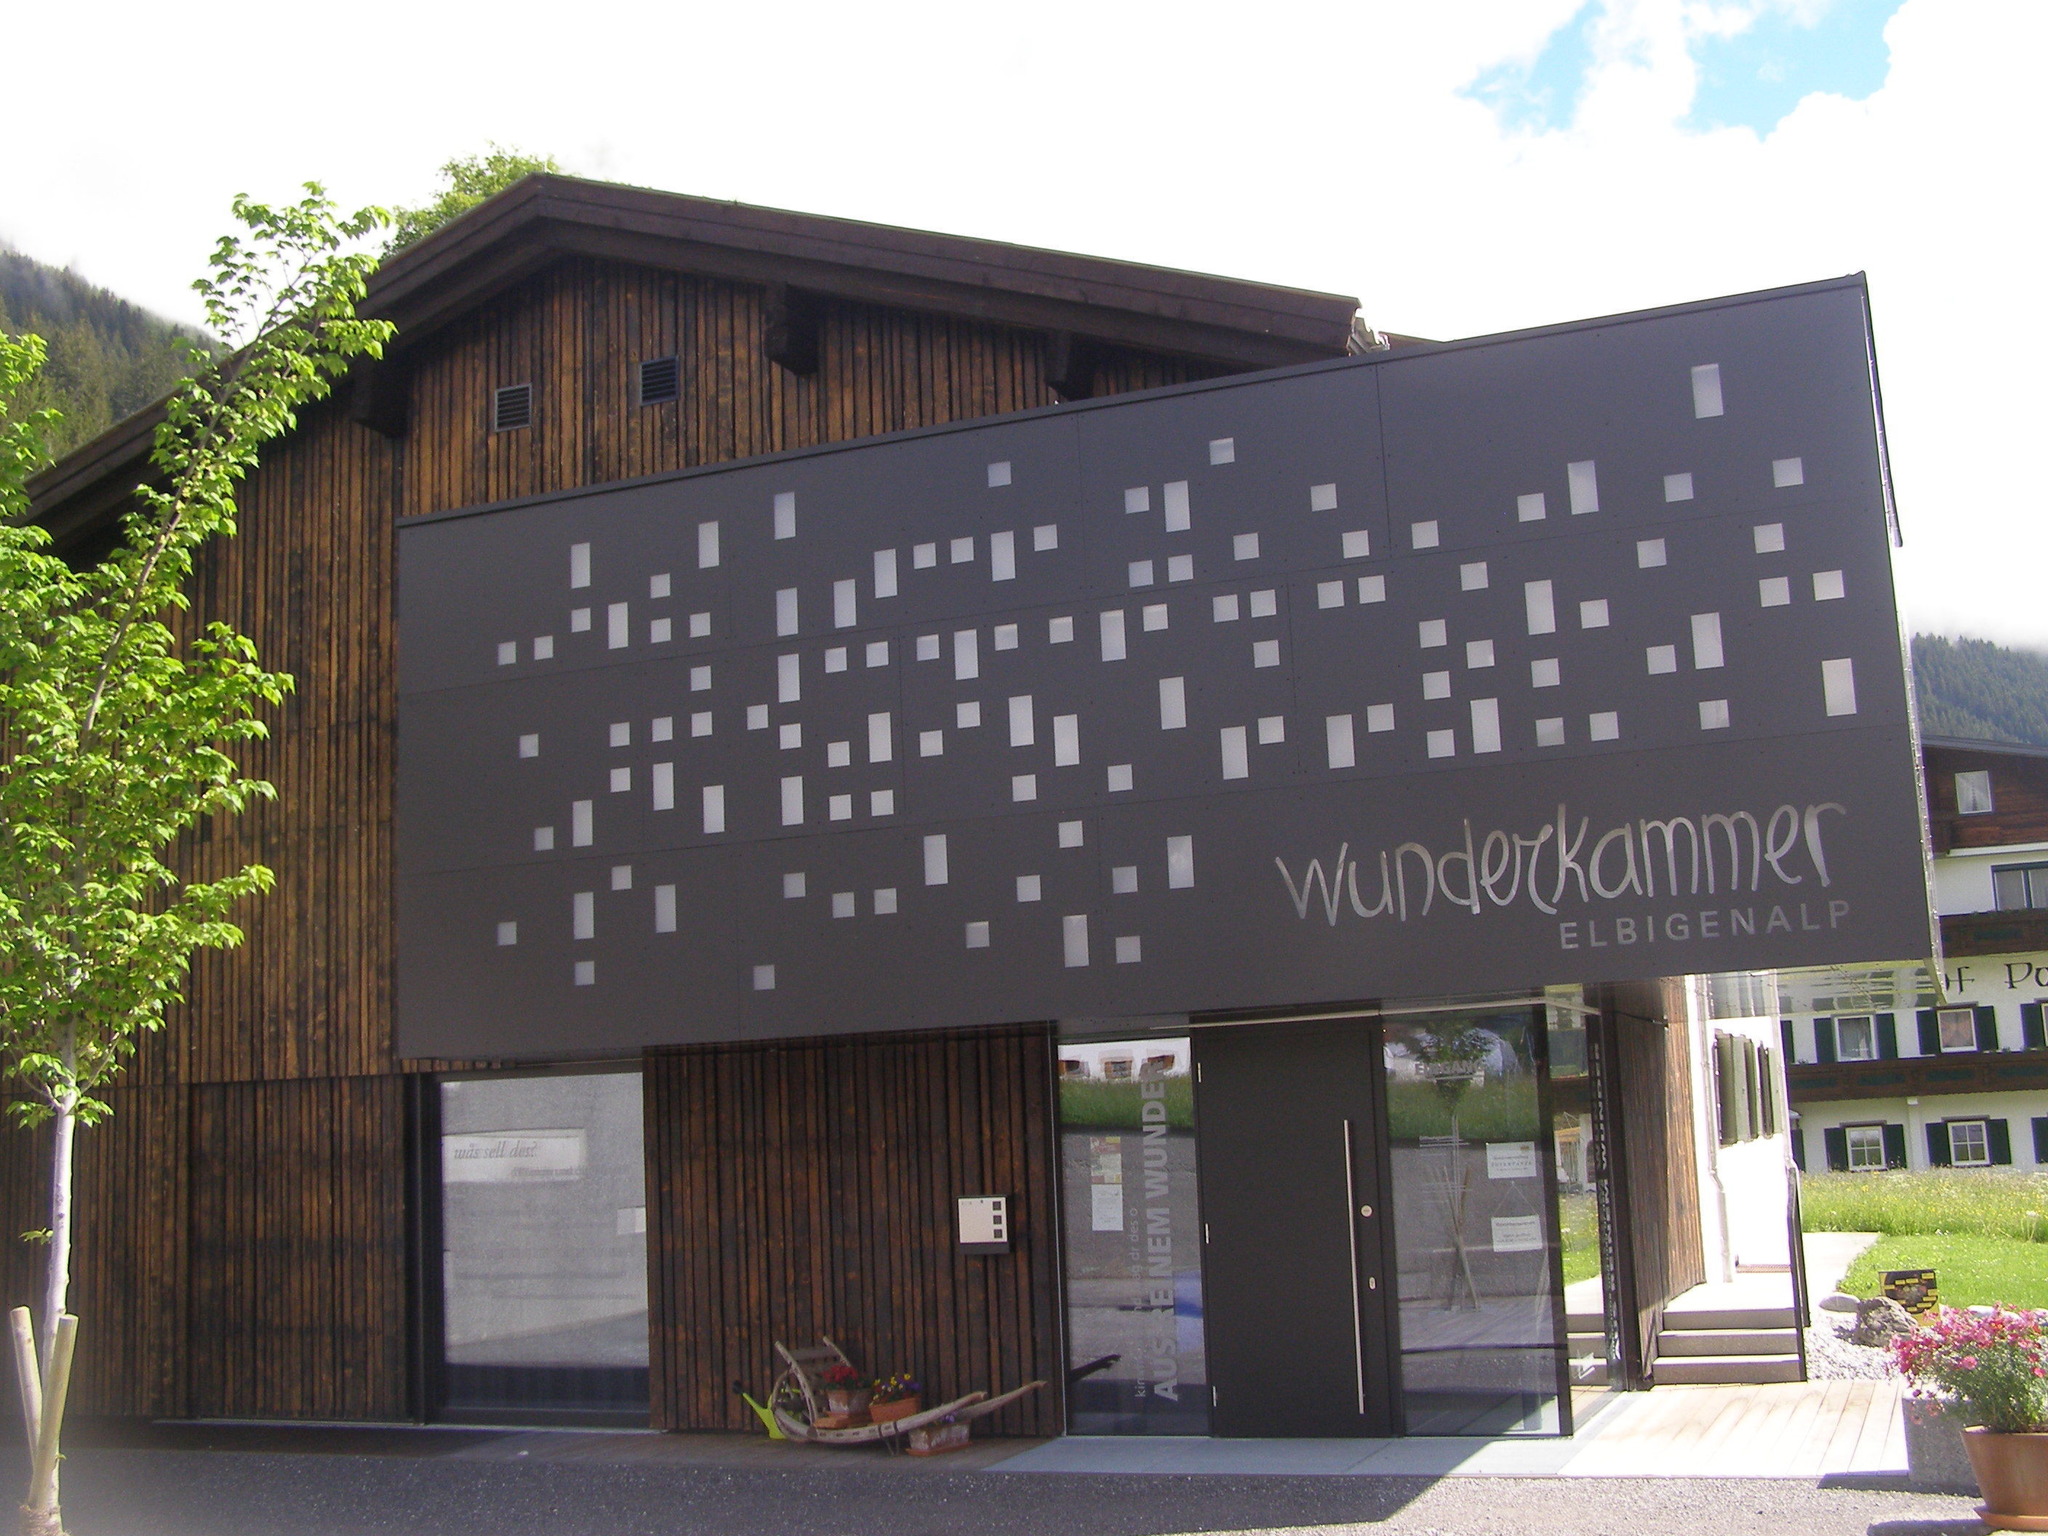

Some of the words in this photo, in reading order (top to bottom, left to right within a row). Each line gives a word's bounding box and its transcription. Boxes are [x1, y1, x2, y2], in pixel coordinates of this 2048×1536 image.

[1560, 900, 1851, 949] ELBIGENALP
[1138, 1061, 1170, 1199] WUNDER
[1150, 1338, 1178, 1401] AUS
